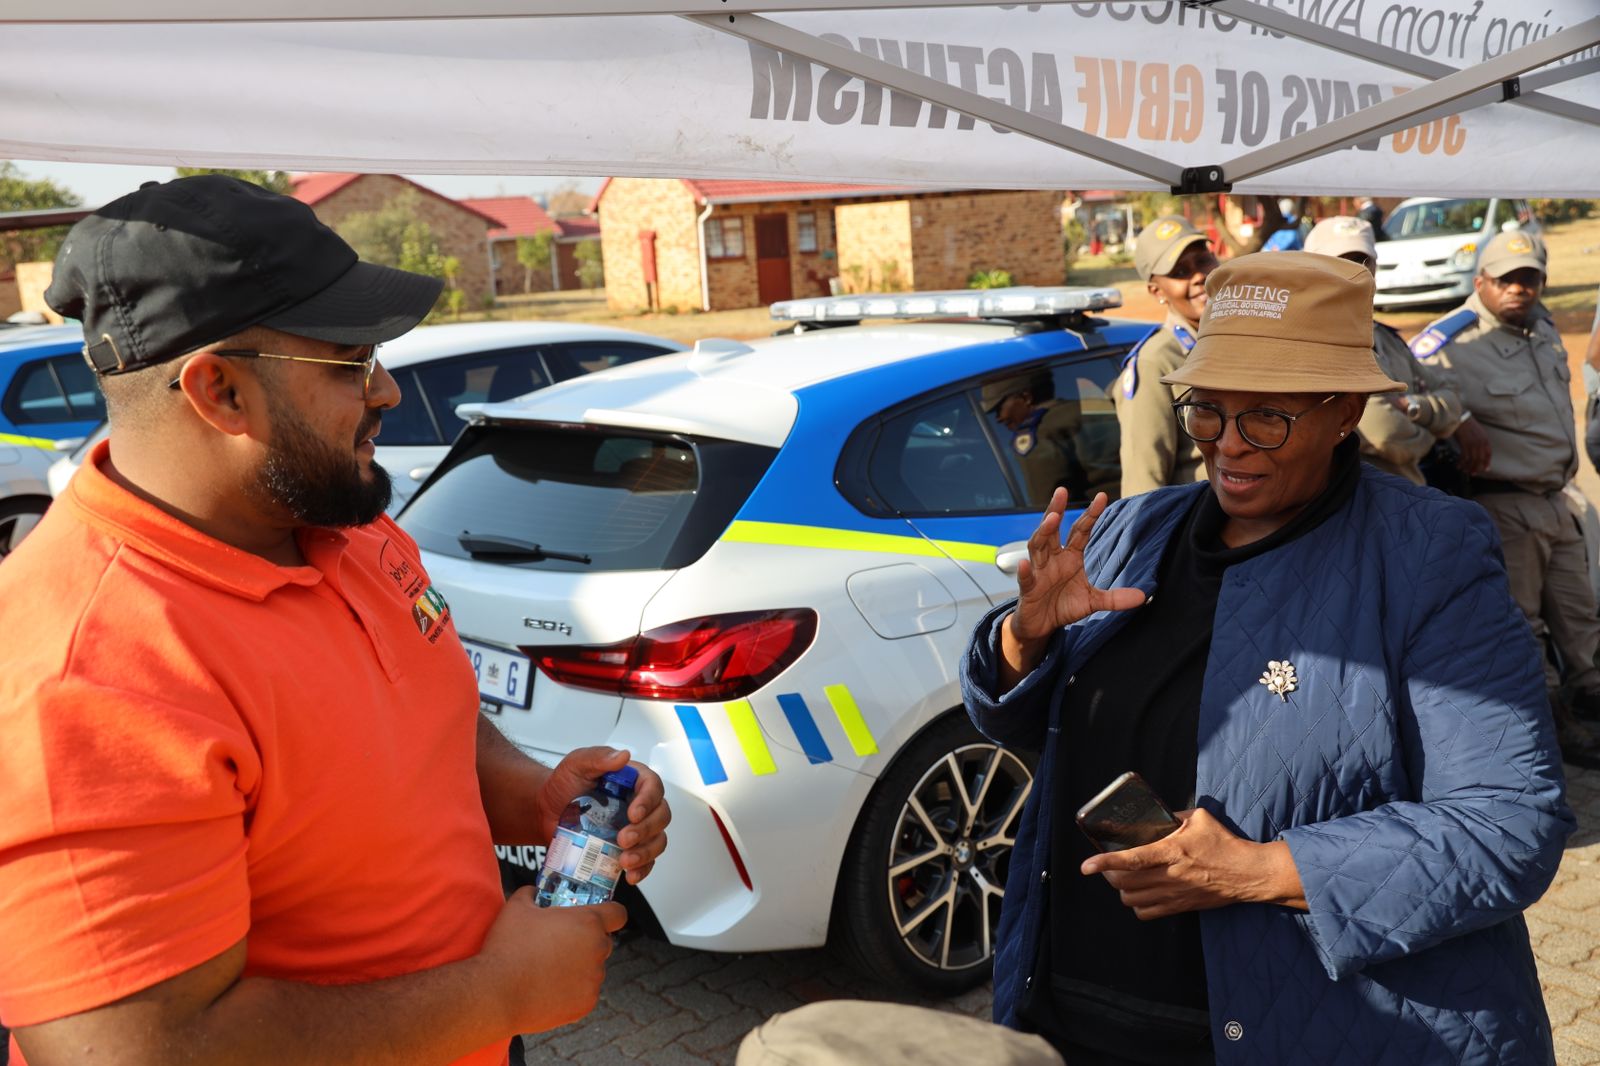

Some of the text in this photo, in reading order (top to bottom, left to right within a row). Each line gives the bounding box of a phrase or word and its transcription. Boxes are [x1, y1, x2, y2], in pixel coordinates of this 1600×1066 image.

[1259, 311, 1282, 319] AFRICA
[506, 661, 518, 697] G
[494, 845, 547, 871] OLICE
